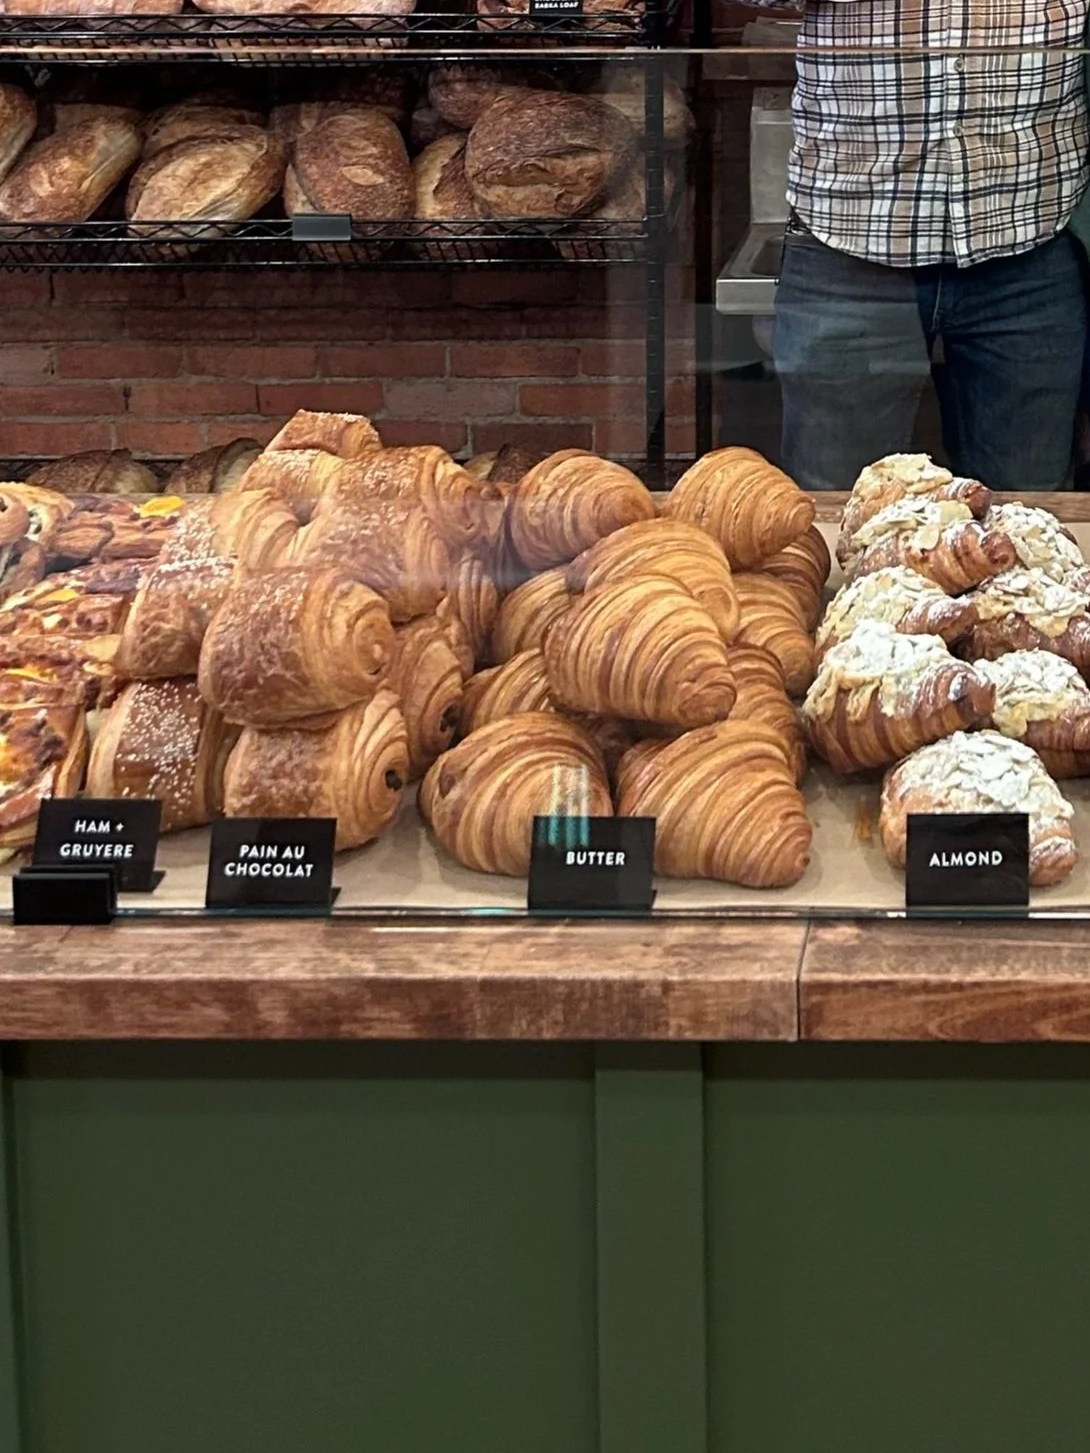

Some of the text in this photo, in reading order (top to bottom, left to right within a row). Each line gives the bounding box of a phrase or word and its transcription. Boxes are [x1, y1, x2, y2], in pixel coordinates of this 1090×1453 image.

[559, 1, 579, 9] LOAF
[74, 819, 111, 834] HAM
[59, 842, 134, 859] GRUYERE
[239, 844, 306, 860] PAIN AU
[565, 850, 626, 866] BUTTER
[929, 850, 1003, 867] ALMOND
[224, 861, 314, 878] CHOCOLAT
